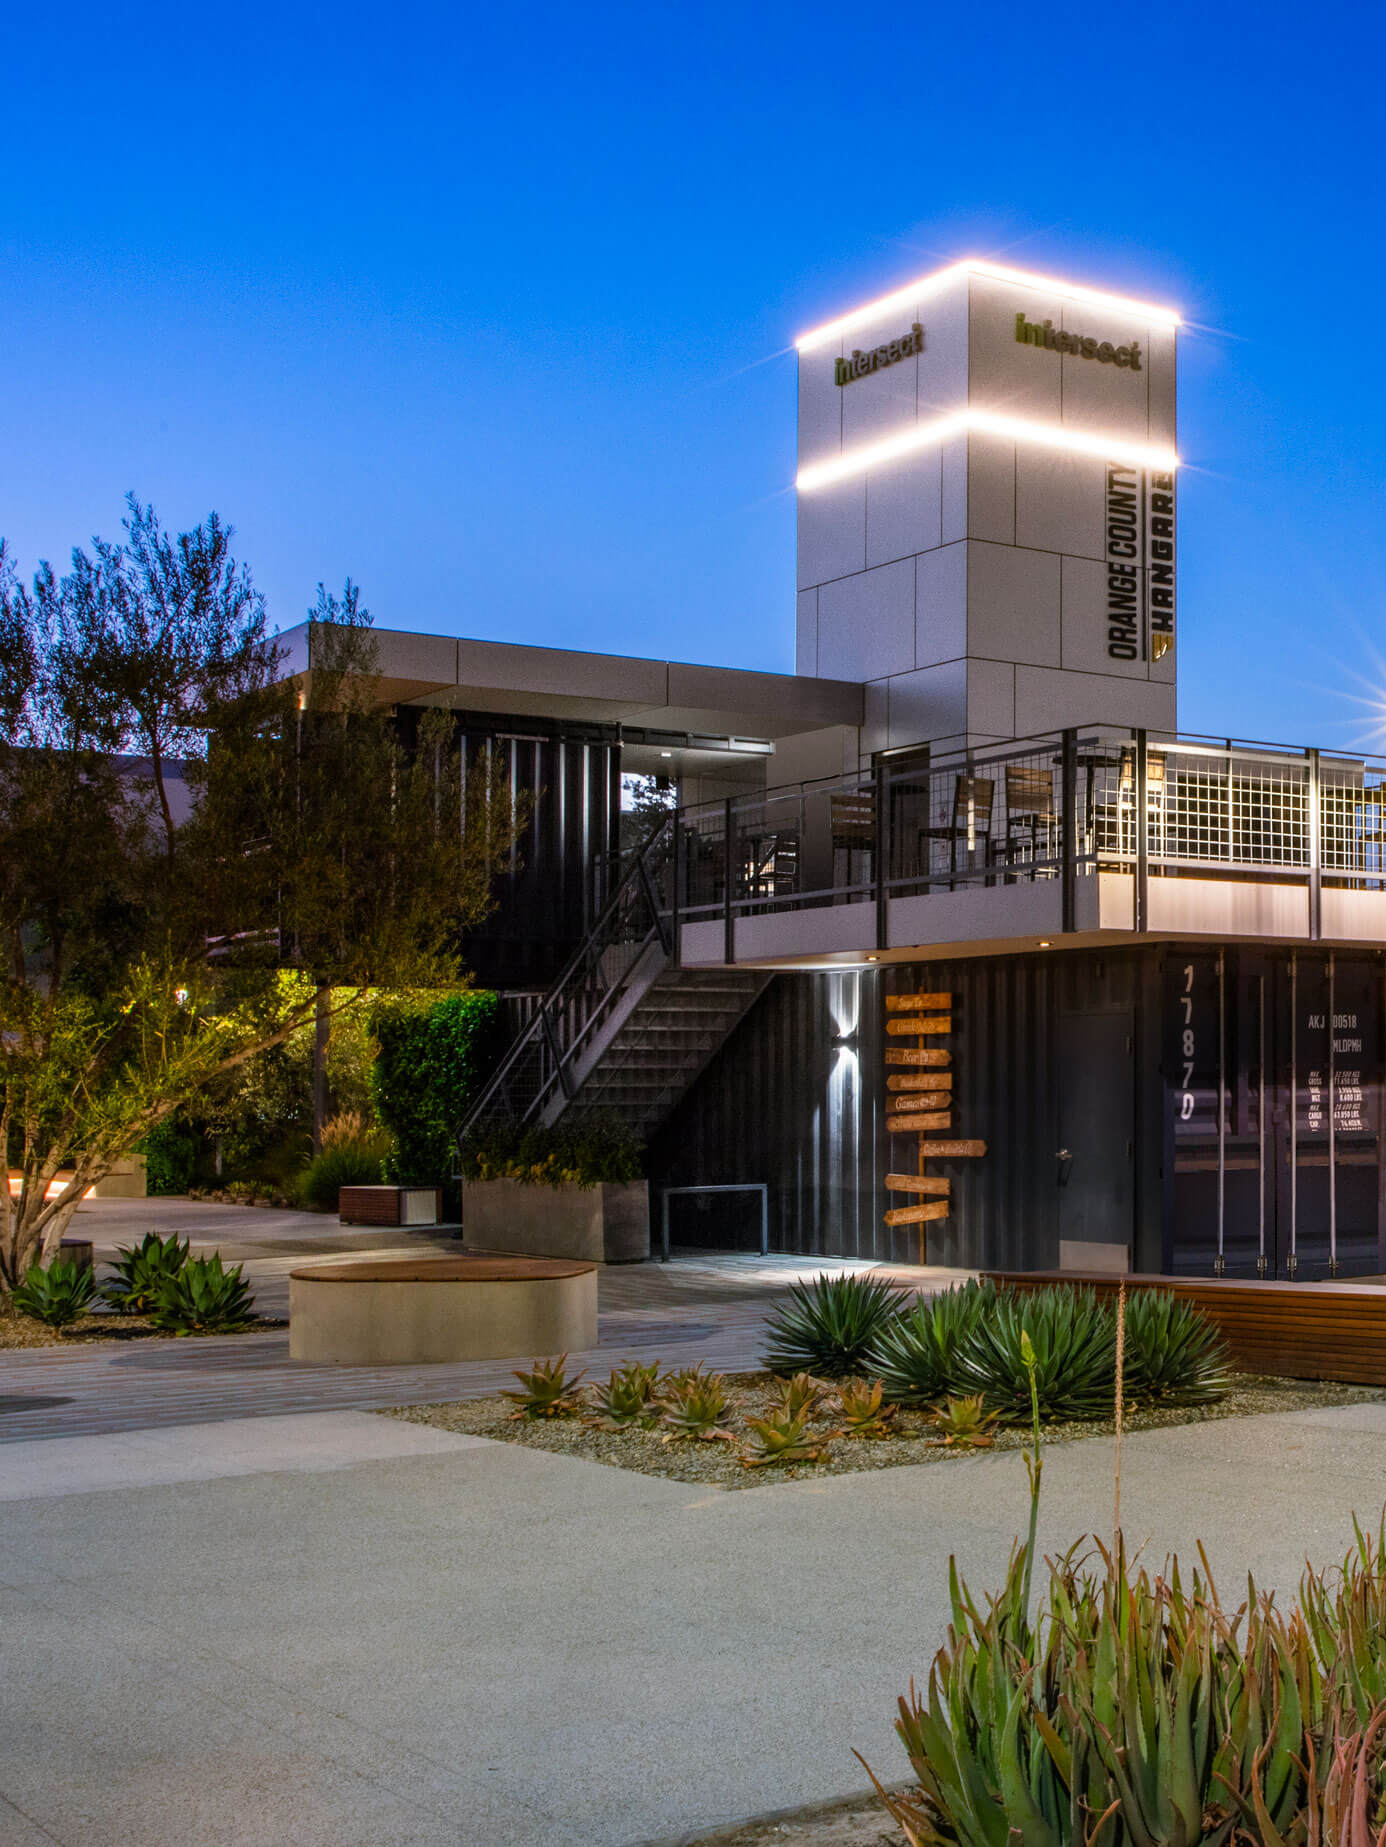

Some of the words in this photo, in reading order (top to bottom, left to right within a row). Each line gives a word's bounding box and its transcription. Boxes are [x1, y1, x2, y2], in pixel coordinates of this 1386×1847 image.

[834, 322, 924, 386] intersect
[1016, 312, 1142, 371] intersect
[1108, 460, 1137, 558] COUNTY
[1151, 493, 1174, 632] HANGAR
[1108, 562, 1137, 661] ORANGE
[1308, 1015, 1326, 1029] AKJ
